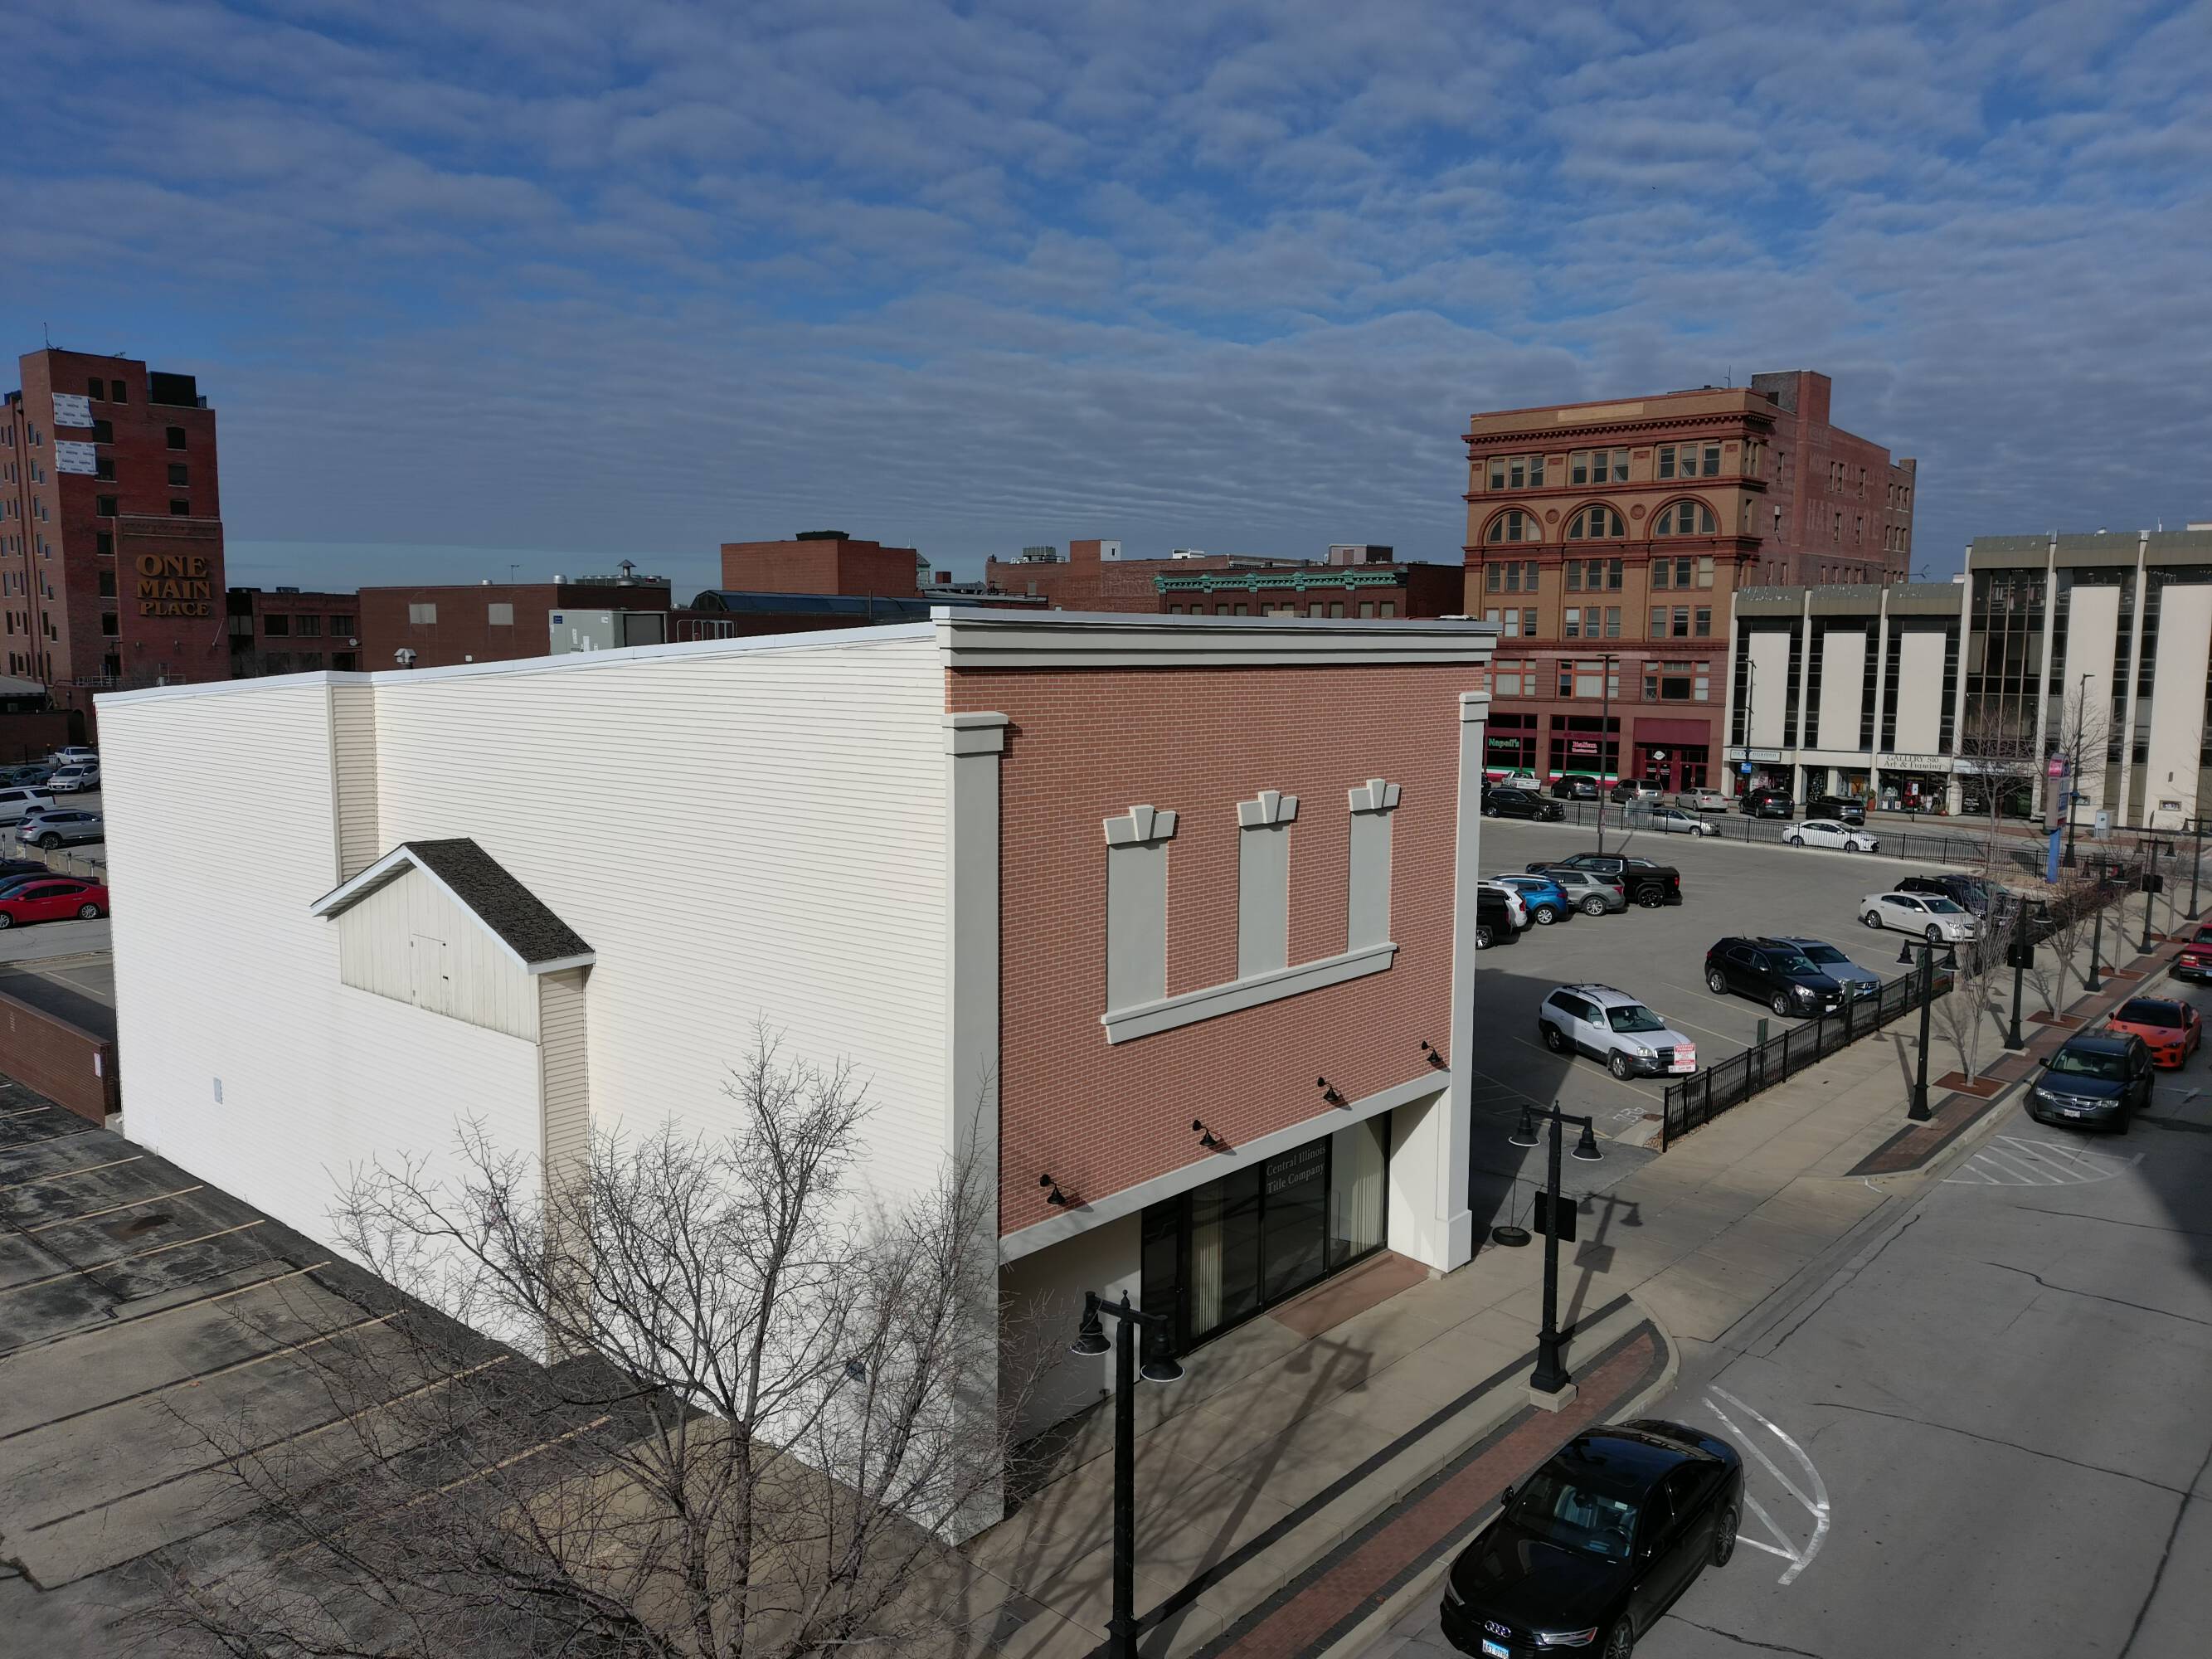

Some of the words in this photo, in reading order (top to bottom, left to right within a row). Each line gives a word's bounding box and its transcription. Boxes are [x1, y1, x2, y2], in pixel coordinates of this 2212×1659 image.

[136, 554, 207, 577] ONE
[137, 580, 212, 599] MAIN
[139, 601, 209, 615] PLACE
[1884, 760, 1897, 768] Art
[1910, 761, 1942, 770] Framing
[1887, 755, 1923, 763] GALLERY
[1266, 1154, 1296, 1176] Central
[1299, 1144, 1326, 1164] Illinois
[1266, 1178, 1286, 1194] Title
[1287, 1163, 1325, 1185] Company
